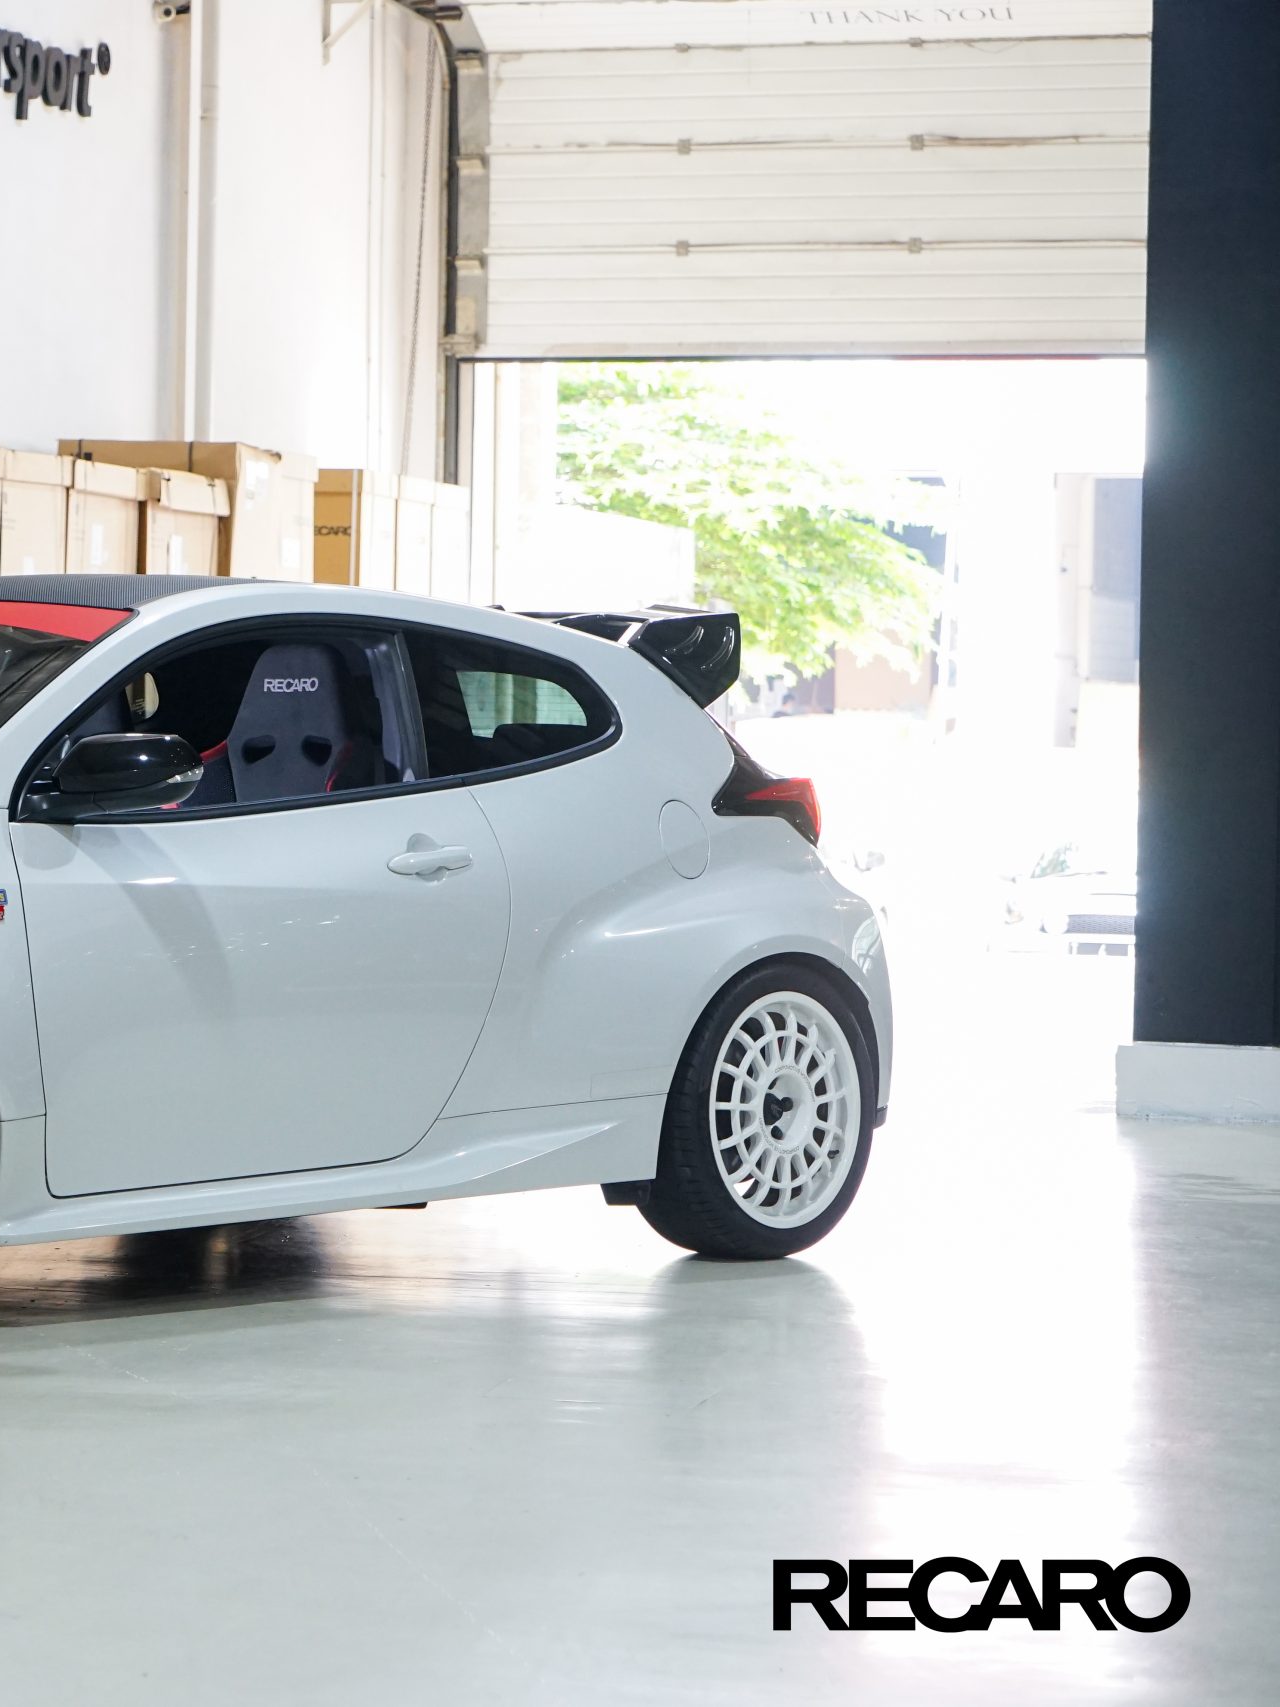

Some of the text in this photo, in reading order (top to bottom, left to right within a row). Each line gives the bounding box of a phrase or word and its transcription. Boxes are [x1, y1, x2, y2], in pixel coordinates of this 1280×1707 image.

[801, 7, 1013, 25] THANK YOU
[263, 677, 319, 693] RECARO
